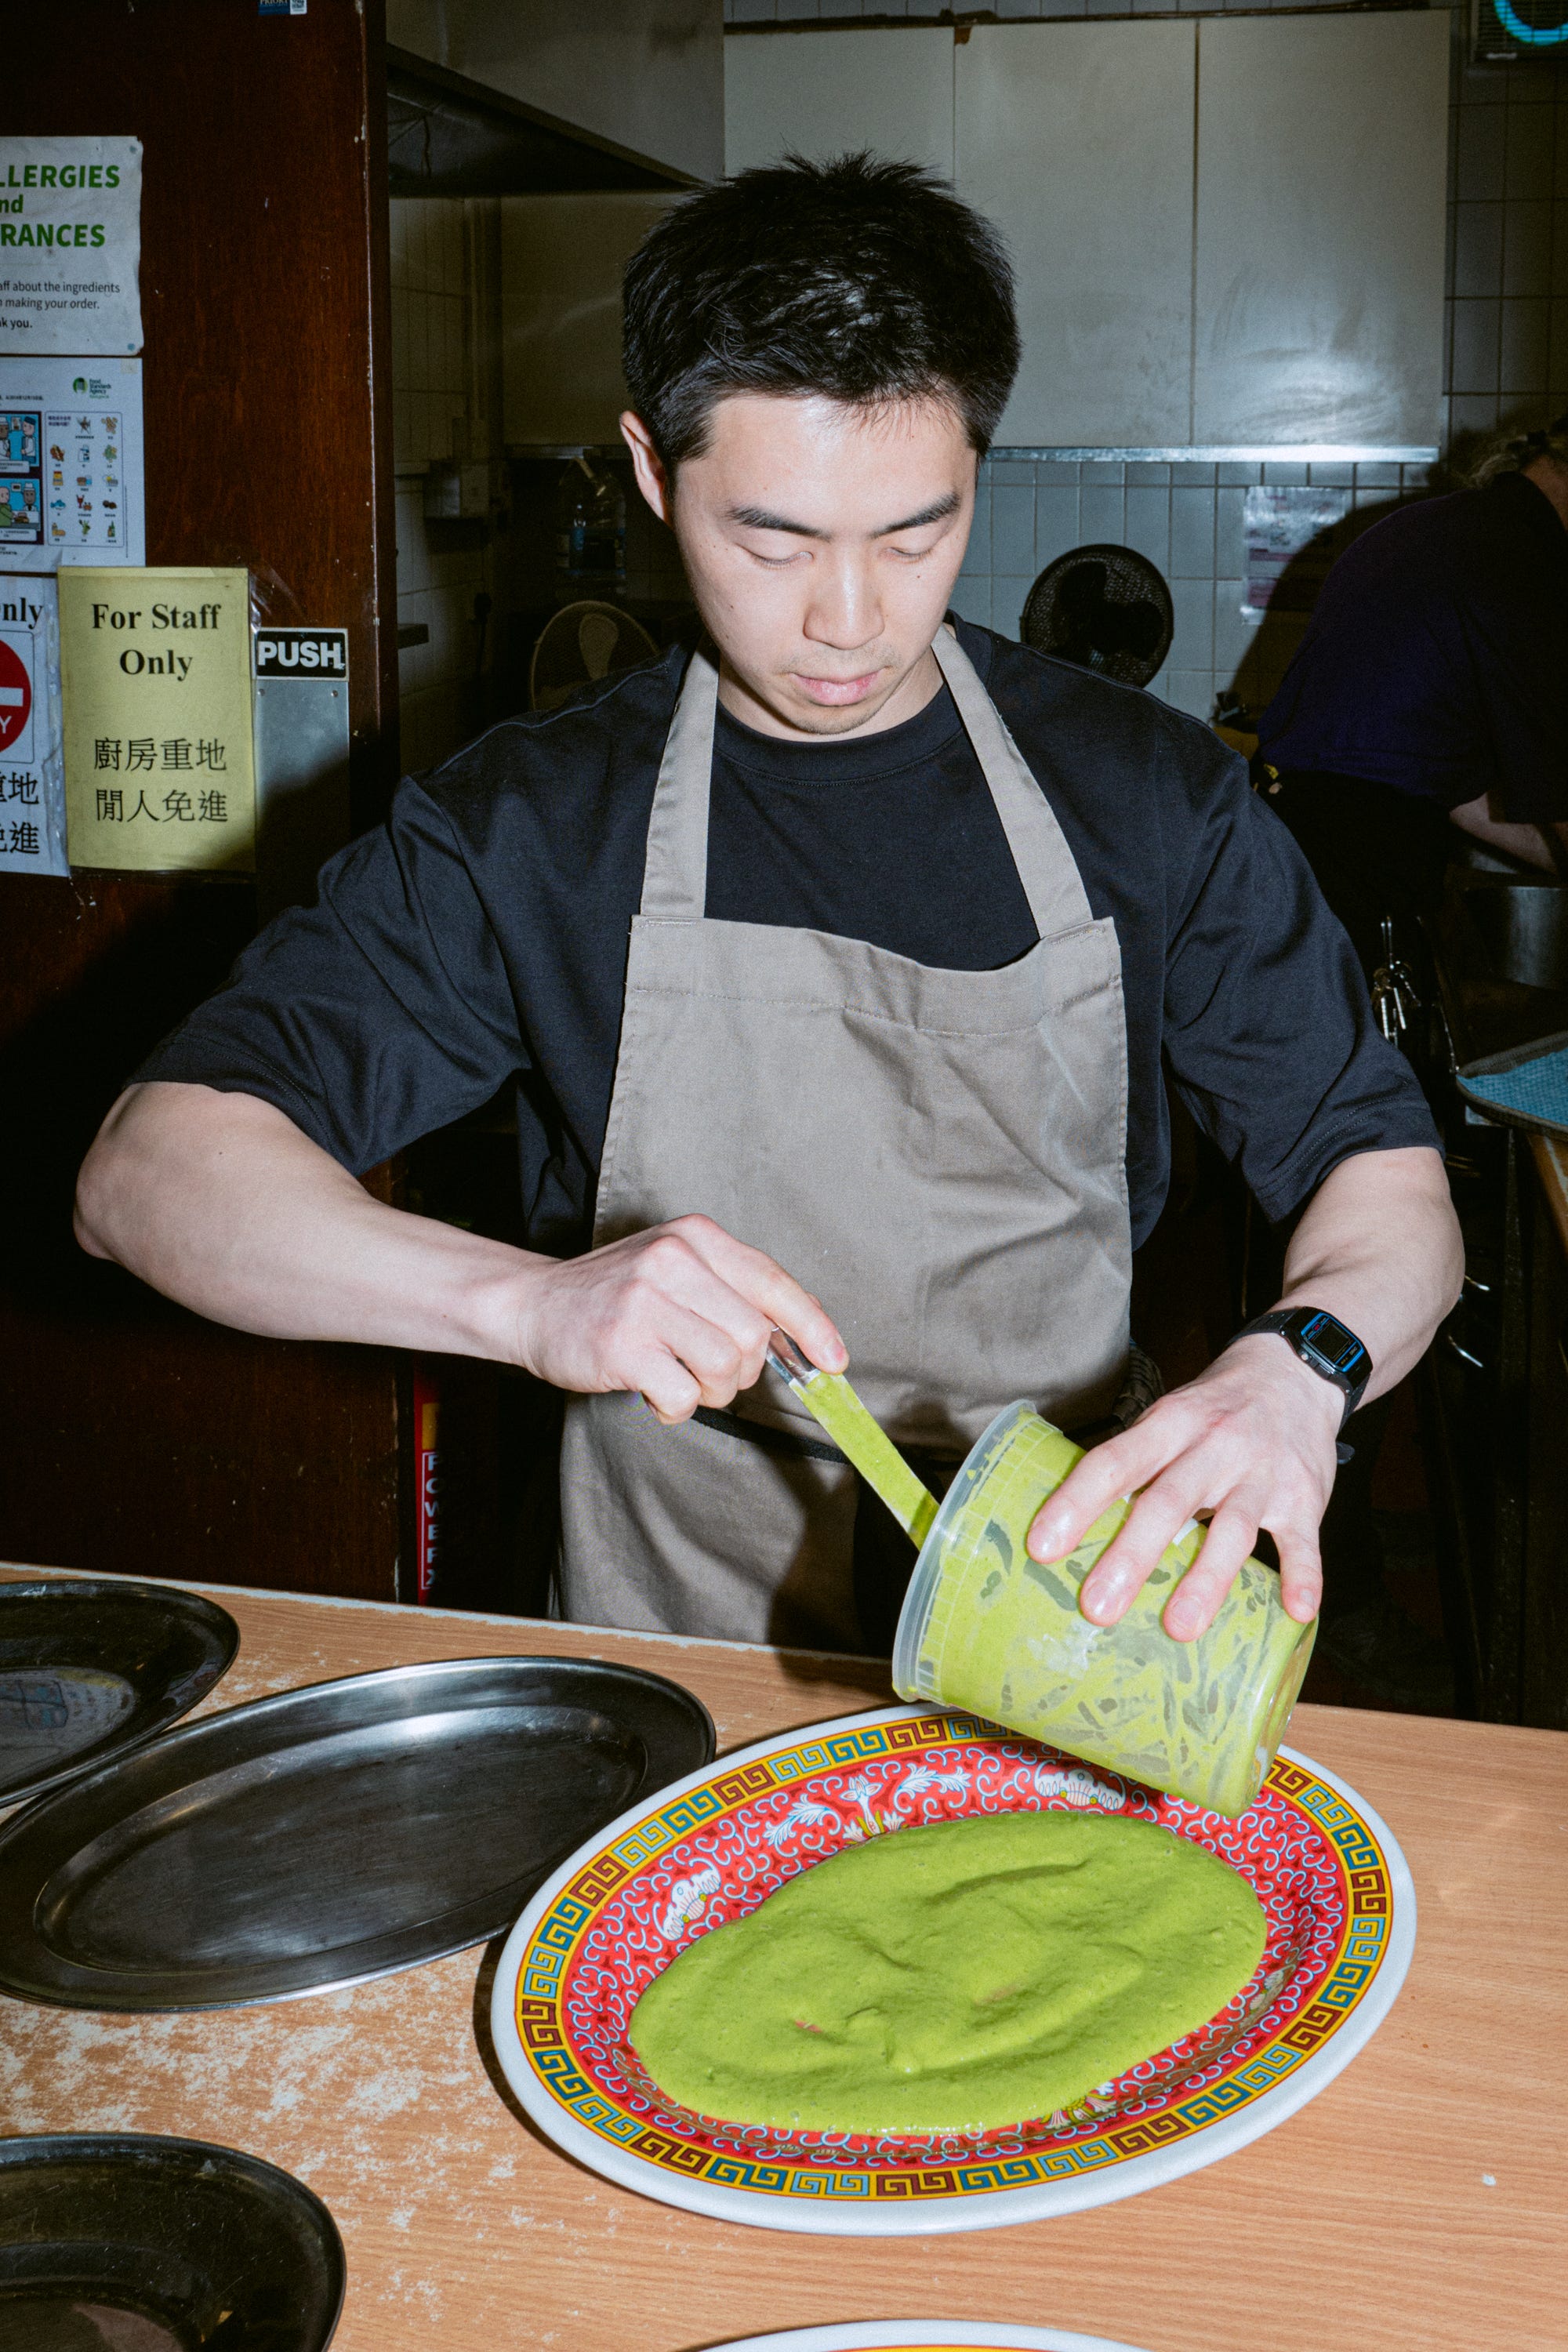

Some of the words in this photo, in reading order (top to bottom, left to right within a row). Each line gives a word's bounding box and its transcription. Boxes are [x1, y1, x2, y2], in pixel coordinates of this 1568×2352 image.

[1, 223, 106, 248] RANCES
[13, 281, 42, 292] about
[44, 281, 60, 292] the
[63, 281, 120, 295] ingredients
[5, 297, 42, 310] making
[45, 300, 67, 310] your
[70, 298, 100, 310] order.
[0, 318, 8, 327] k
[10, 318, 32, 330] you.
[0, 597, 43, 630] nly
[92, 604, 142, 630] For
[152, 604, 221, 630] Staff
[120, 649, 193, 681] Only
[258, 641, 345, 669] PUSH
[94, 737, 227, 771] 廚房重地
[0, 771, 39, 805] 地
[0, 821, 40, 855] 進
